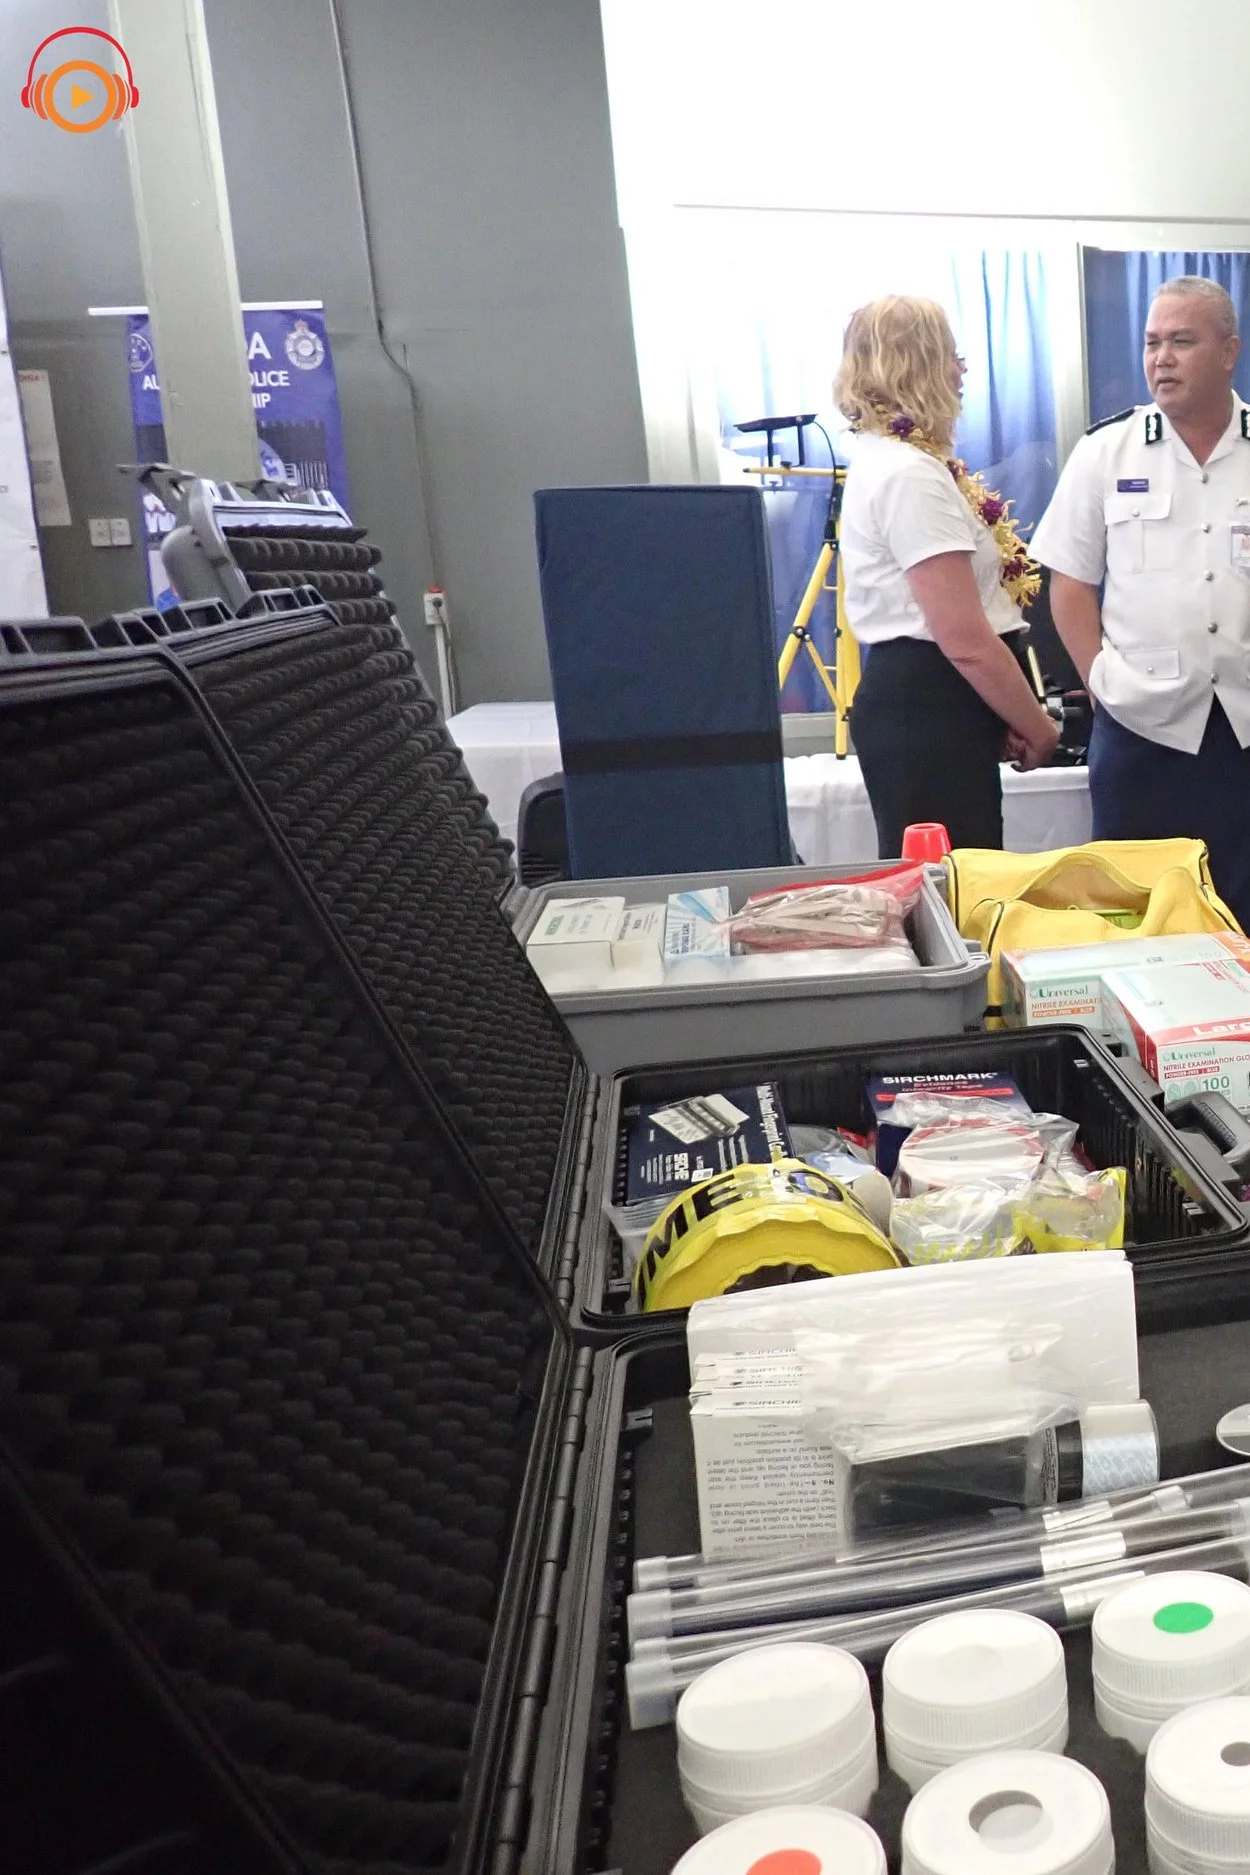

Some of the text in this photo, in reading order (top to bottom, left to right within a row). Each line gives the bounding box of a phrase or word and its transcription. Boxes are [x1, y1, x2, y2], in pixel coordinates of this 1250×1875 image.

[1038, 985, 1088, 997] Universal
[1170, 1047, 1216, 1061] Universal
[1163, 1062, 1187, 1072] NITRILE
[1187, 1057, 1235, 1068] EXAMINATION
[882, 1073, 992, 1084] SIRCHMARK
[1202, 1075, 1231, 1090] 100
